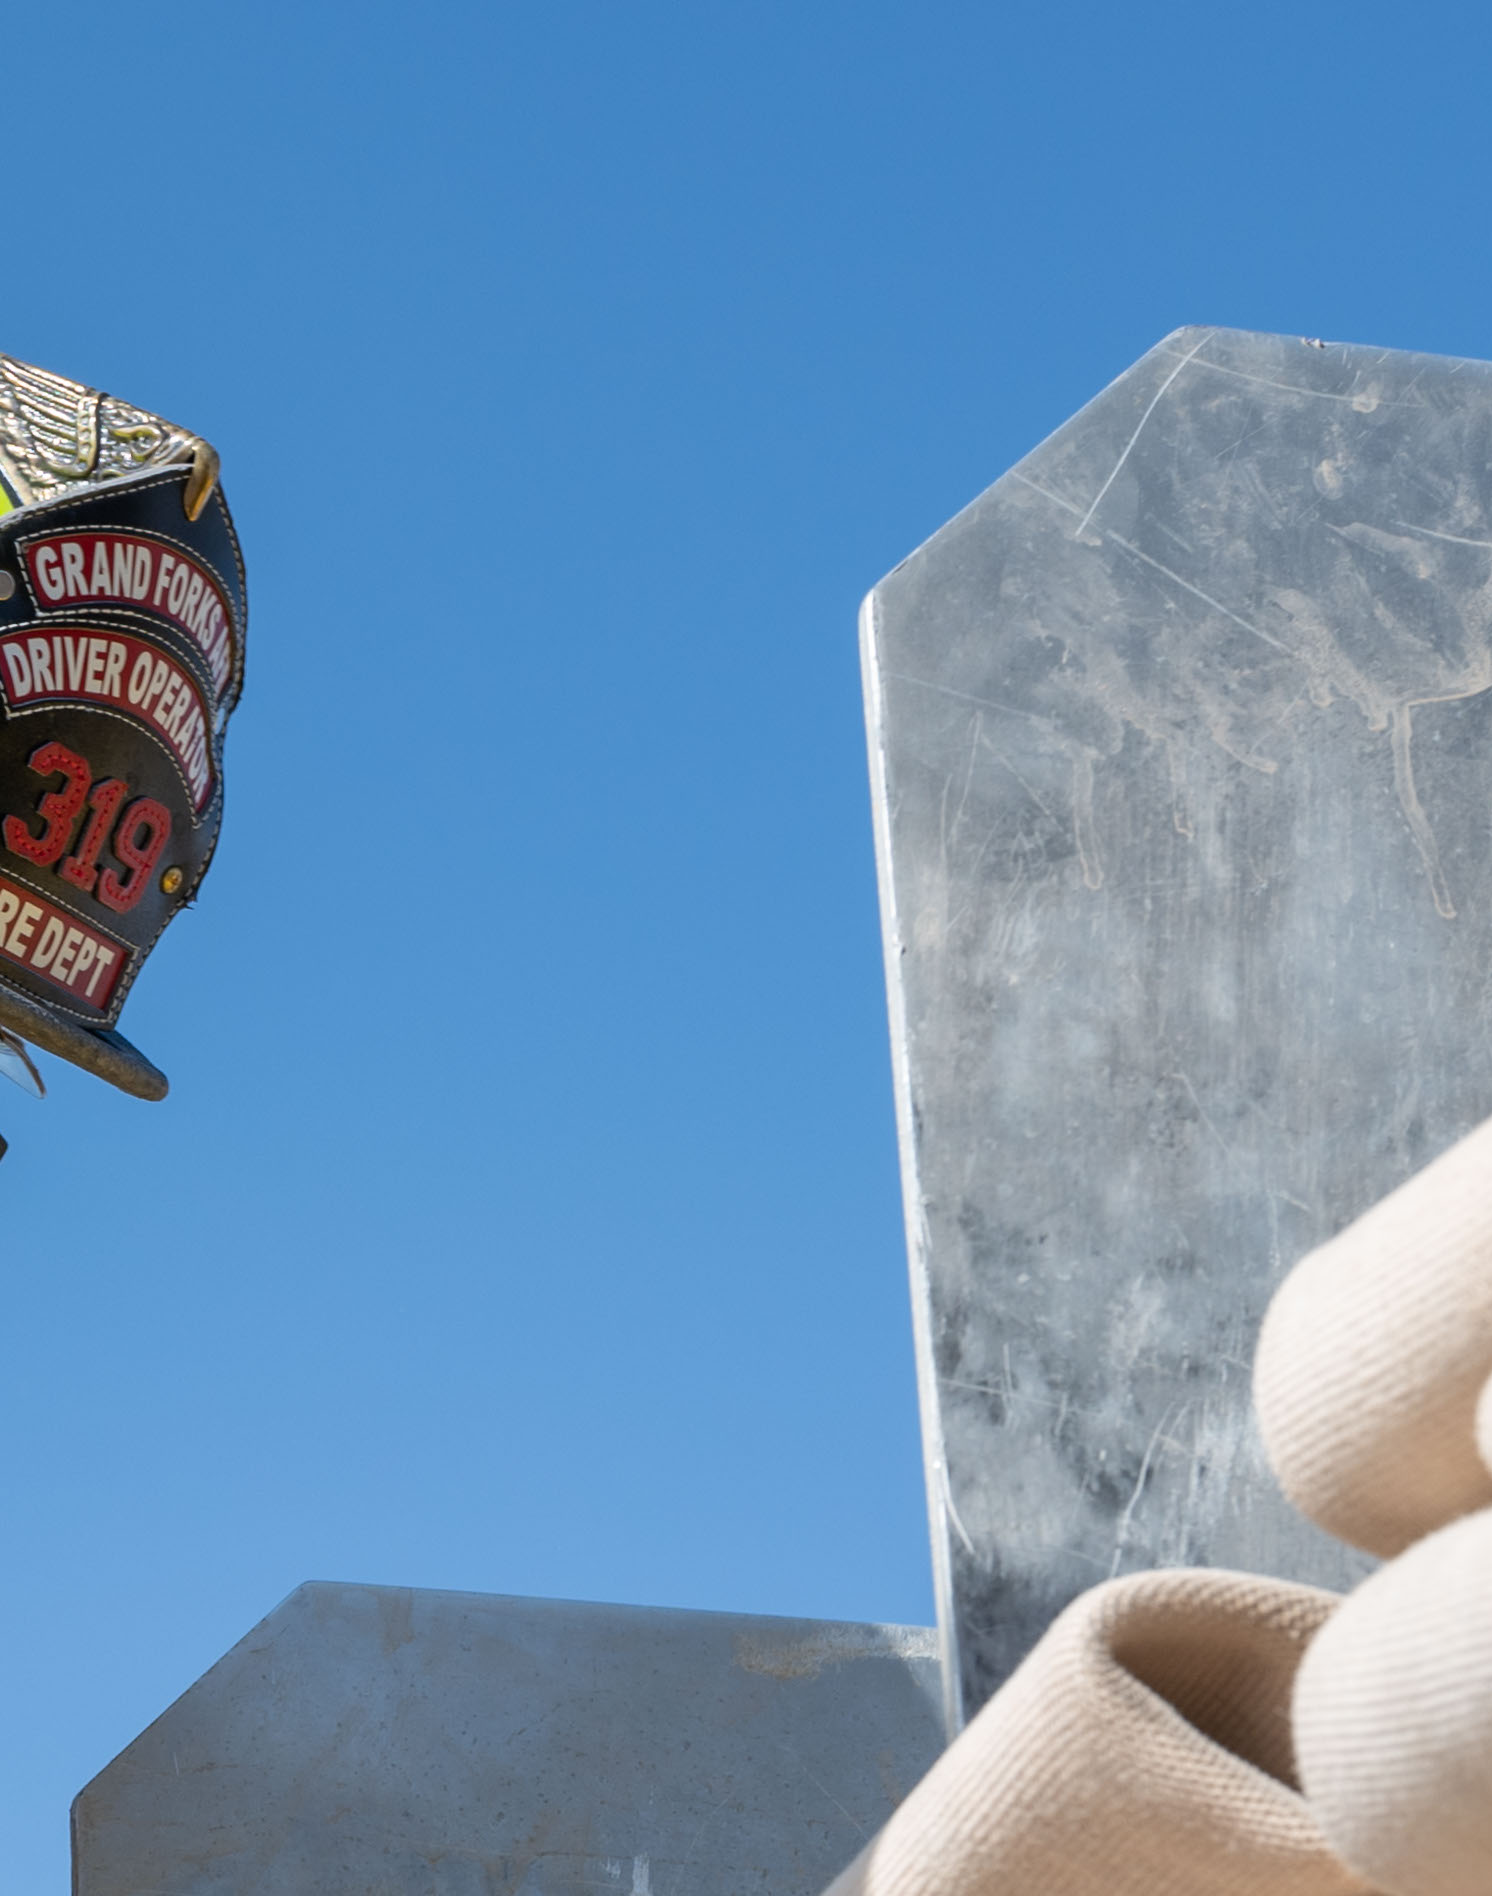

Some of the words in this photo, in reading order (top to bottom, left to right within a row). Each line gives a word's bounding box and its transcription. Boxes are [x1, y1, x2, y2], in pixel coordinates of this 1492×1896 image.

[35, 541, 152, 601] GRAND
[153, 553, 223, 651] FORKS
[1, 635, 128, 699] DRIVER
[127, 651, 211, 803] OPERATOR
[2, 740, 173, 915] 319
[30, 916, 115, 997] DEPT
